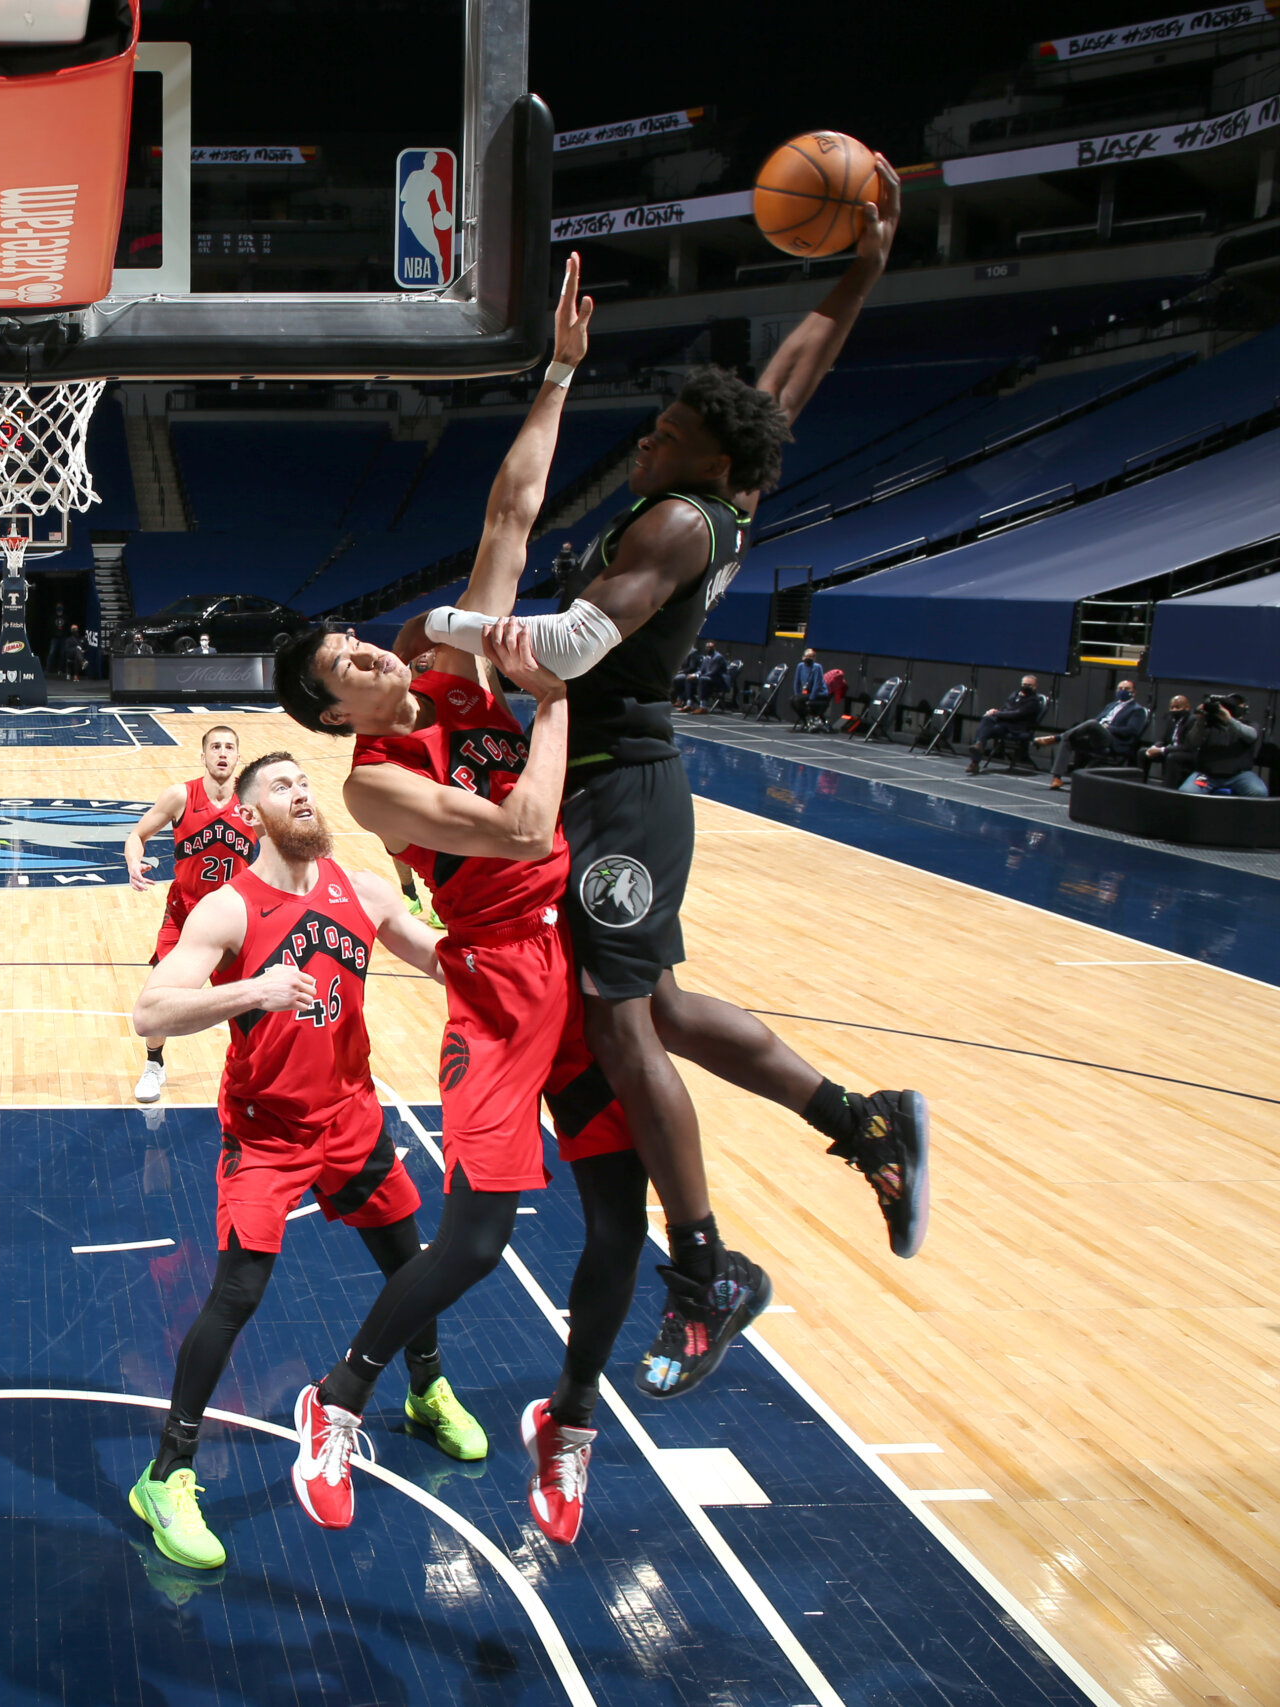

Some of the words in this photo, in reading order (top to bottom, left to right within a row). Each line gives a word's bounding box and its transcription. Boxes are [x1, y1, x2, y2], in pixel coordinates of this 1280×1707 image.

[404, 257, 432, 279] NBA
[986, 264, 1008, 278] 106
[23, 673, 35, 681] MN
[451, 734, 530, 795] PTORS
[184, 825, 249, 856] RAPTORS
[201, 855, 234, 883] 21
[266, 921, 366, 971] APTORS
[295, 974, 342, 1028] 46
